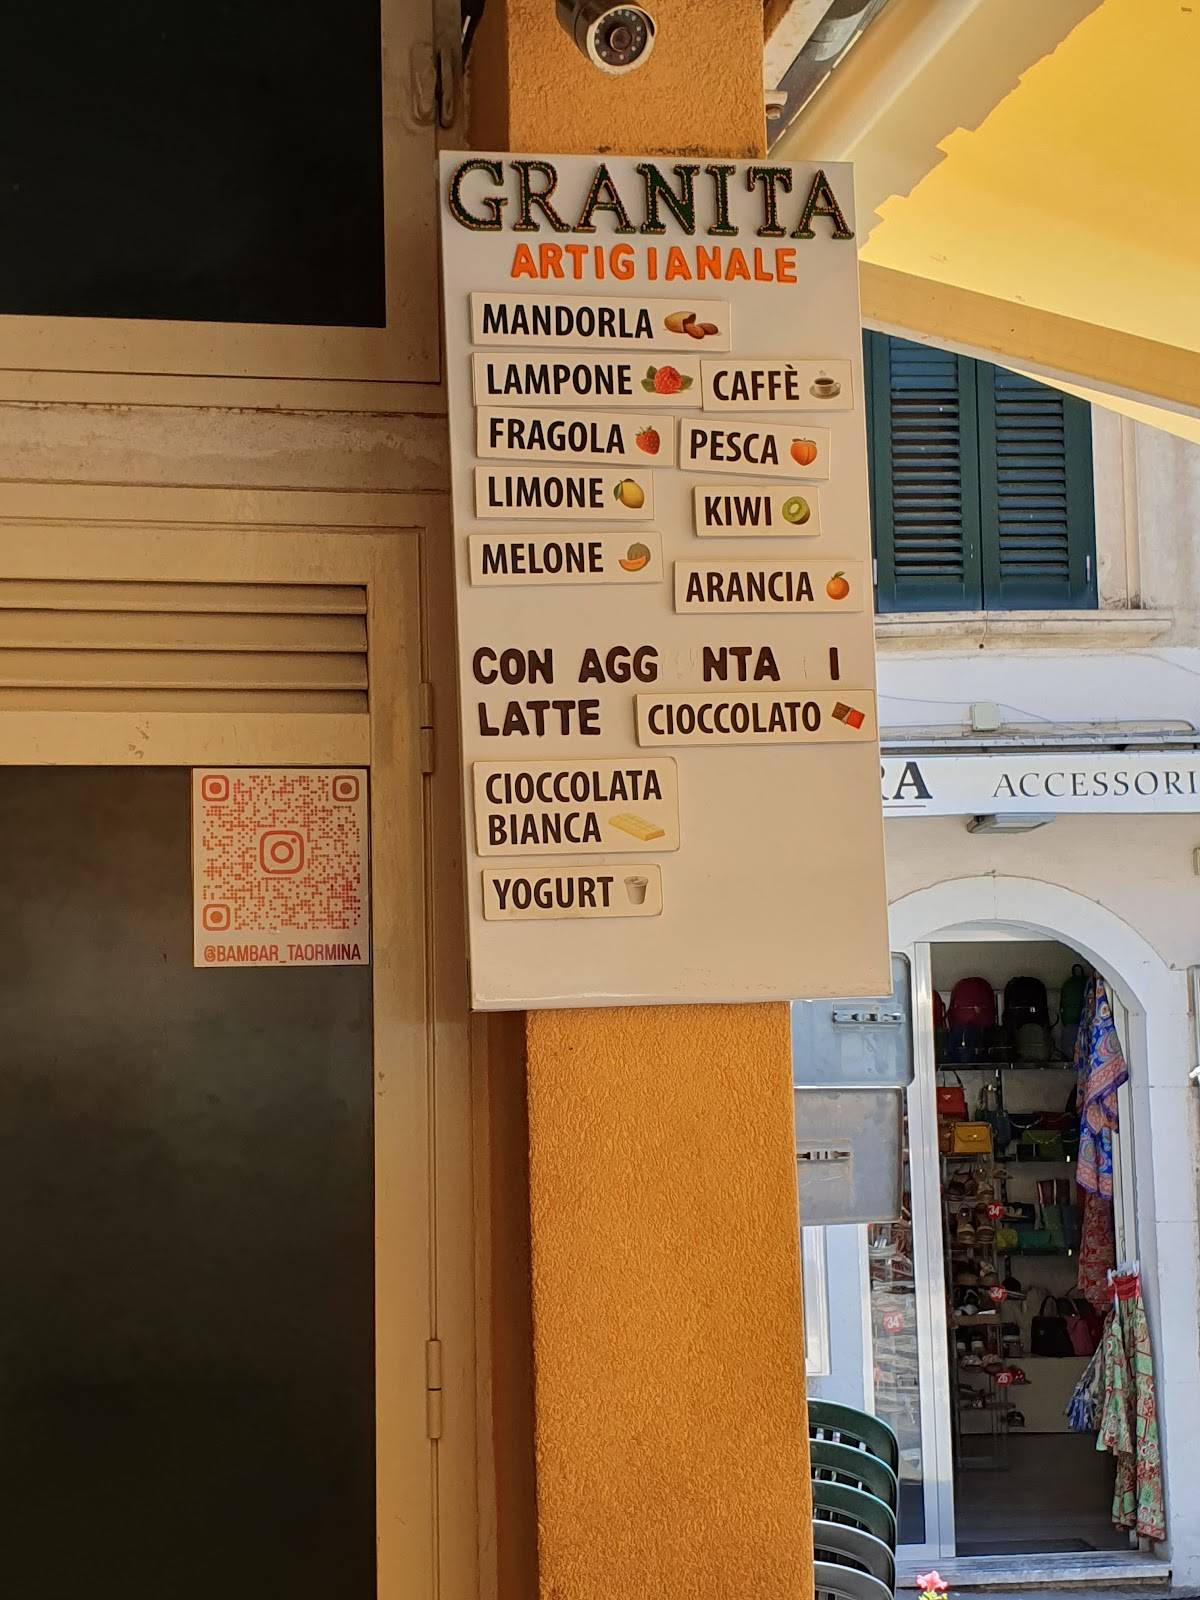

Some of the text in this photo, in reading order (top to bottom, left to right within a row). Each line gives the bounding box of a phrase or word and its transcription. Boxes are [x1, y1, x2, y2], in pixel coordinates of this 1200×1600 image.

[448, 158, 855, 240] GRANITA
[510, 242, 797, 283] ARTIGIANALE
[482, 303, 654, 339] MANDORLA
[486, 364, 633, 395] LAMPONE
[712, 364, 800, 401] CAFFÈ
[489, 417, 625, 454] FRAGOLA
[690, 429, 779, 465] PESCA
[488, 476, 604, 509] LIMONE
[704, 495, 772, 526] KIWI
[482, 542, 604, 574] MELONE
[685, 571, 815, 602] ARANCIA
[472, 646, 554, 684] CON
[478, 699, 601, 737] LATTE
[648, 701, 822, 735] CIOCCOLATO
[485, 769, 663, 804] CIOCCOLATA
[992, 770, 1198, 799] ACCESSORI
[488, 811, 602, 846] BIANCA
[492, 876, 614, 910] YOGURT
[203, 944, 362, 964] @BAMBAR_TAORMINA
